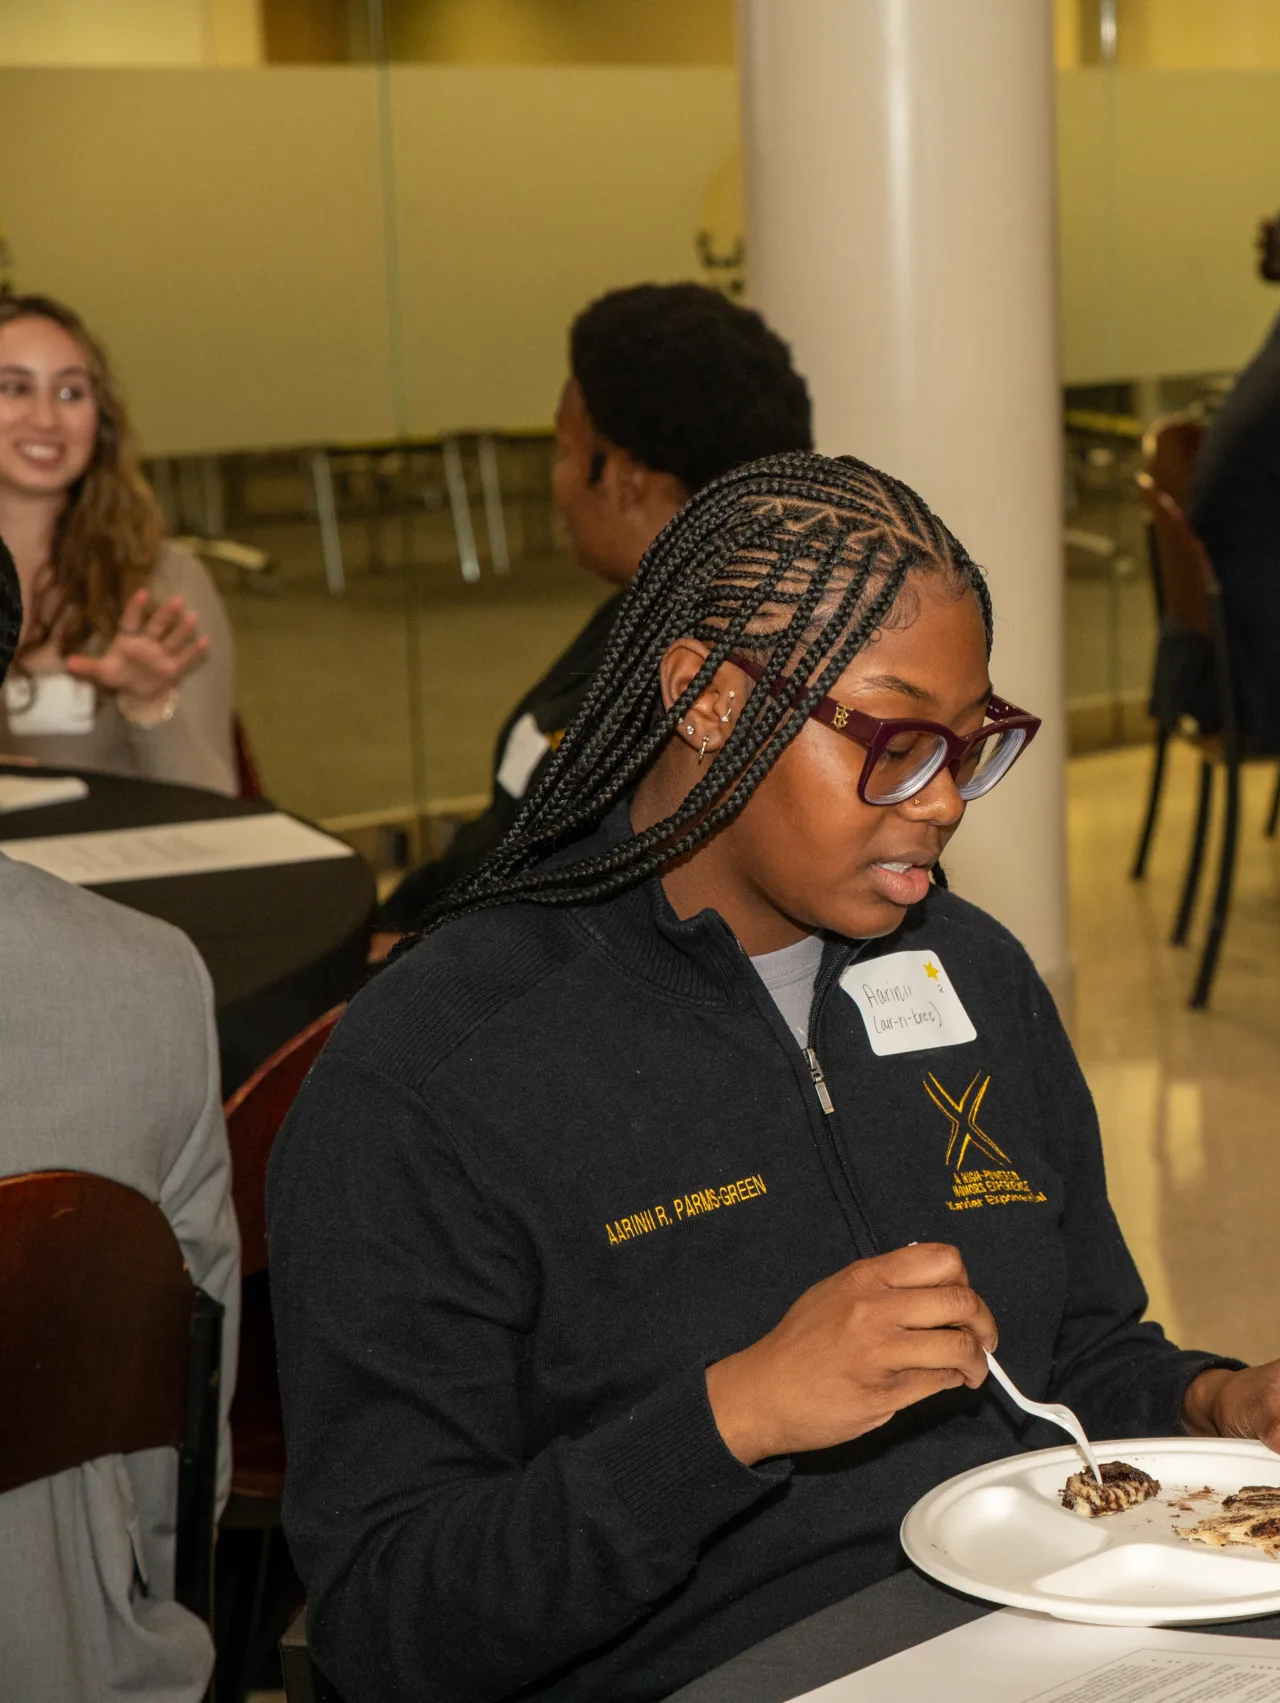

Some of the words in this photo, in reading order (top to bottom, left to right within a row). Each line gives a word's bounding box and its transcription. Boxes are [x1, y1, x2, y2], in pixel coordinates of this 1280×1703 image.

[952, 1182, 987, 1197] HONORS
[605, 1209, 657, 1245] AARINII
[655, 1206, 673, 1227] R.
[673, 1174, 767, 1221] PARMS-GREEN
[945, 1197, 984, 1211] Xavier
